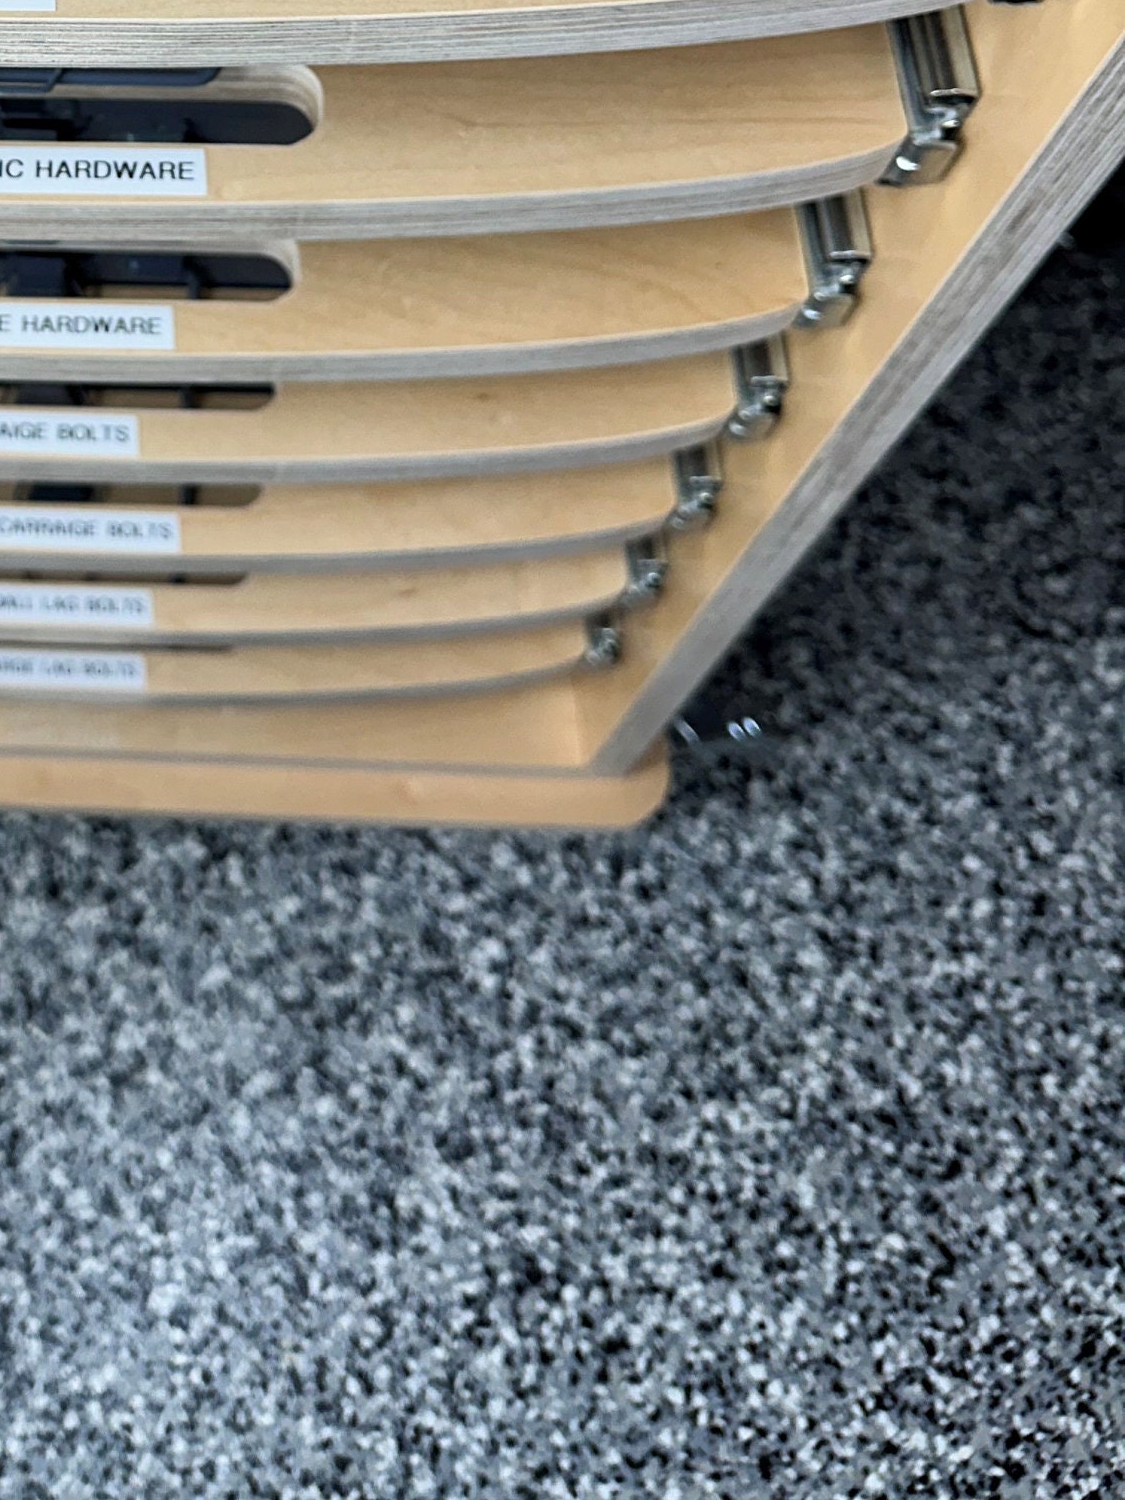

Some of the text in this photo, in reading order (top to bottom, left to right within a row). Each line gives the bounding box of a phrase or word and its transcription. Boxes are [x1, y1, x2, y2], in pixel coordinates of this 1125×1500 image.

[33, 159, 196, 181] HARDWARE
[20, 314, 163, 336] HARDWARE
[55, 422, 130, 443] BOLTS
[106, 520, 174, 540] BOLTS
[86, 595, 145, 614] BOLTS
